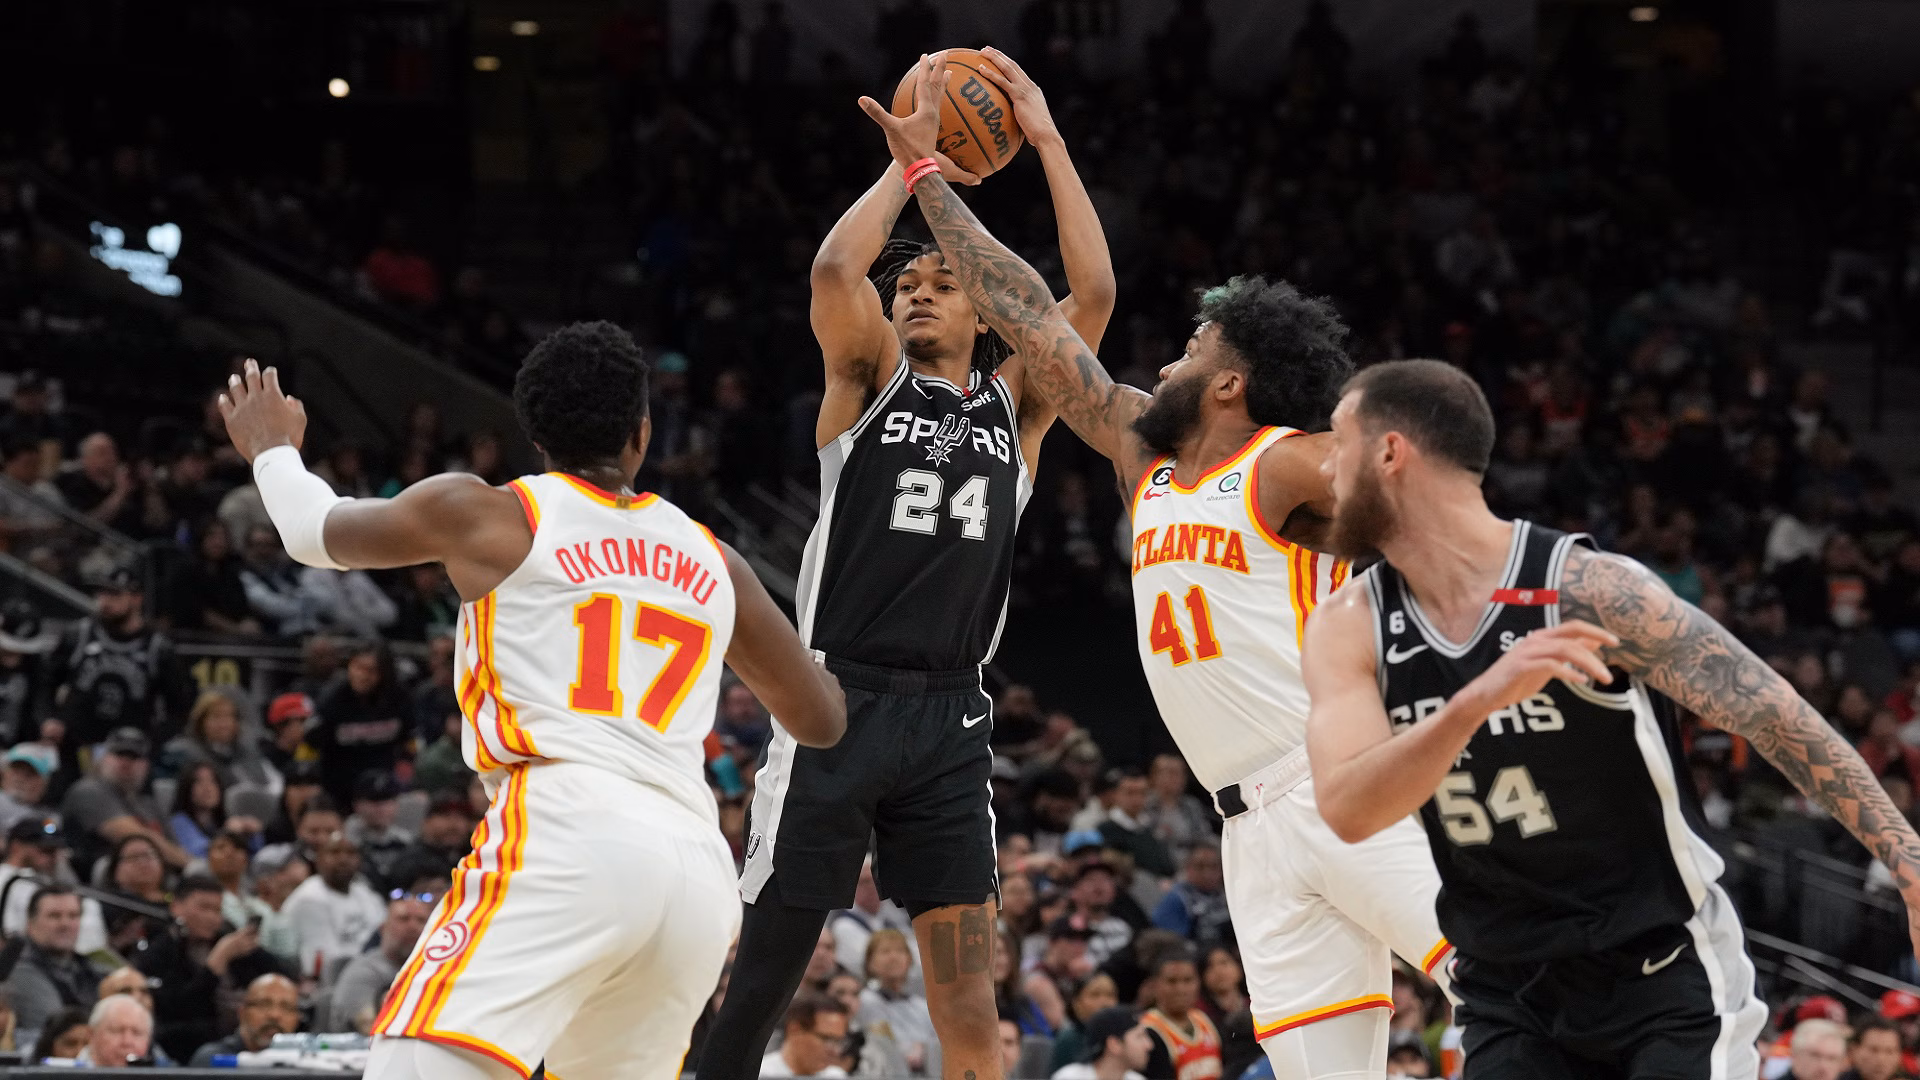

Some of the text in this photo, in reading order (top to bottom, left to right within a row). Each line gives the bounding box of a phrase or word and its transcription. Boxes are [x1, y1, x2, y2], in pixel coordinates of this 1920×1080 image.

[960, 76, 1010, 159] Wilson
[880, 411, 1010, 464] SPURS
[889, 467, 990, 541] 24
[1154, 468, 1171, 484] 6
[555, 538, 718, 606] OKONGWU
[1133, 523, 1250, 576] TLANTA
[1149, 584, 1223, 667] 41
[1389, 610, 1406, 635] 6
[568, 592, 713, 735] 17
[1433, 765, 1559, 847] 54
